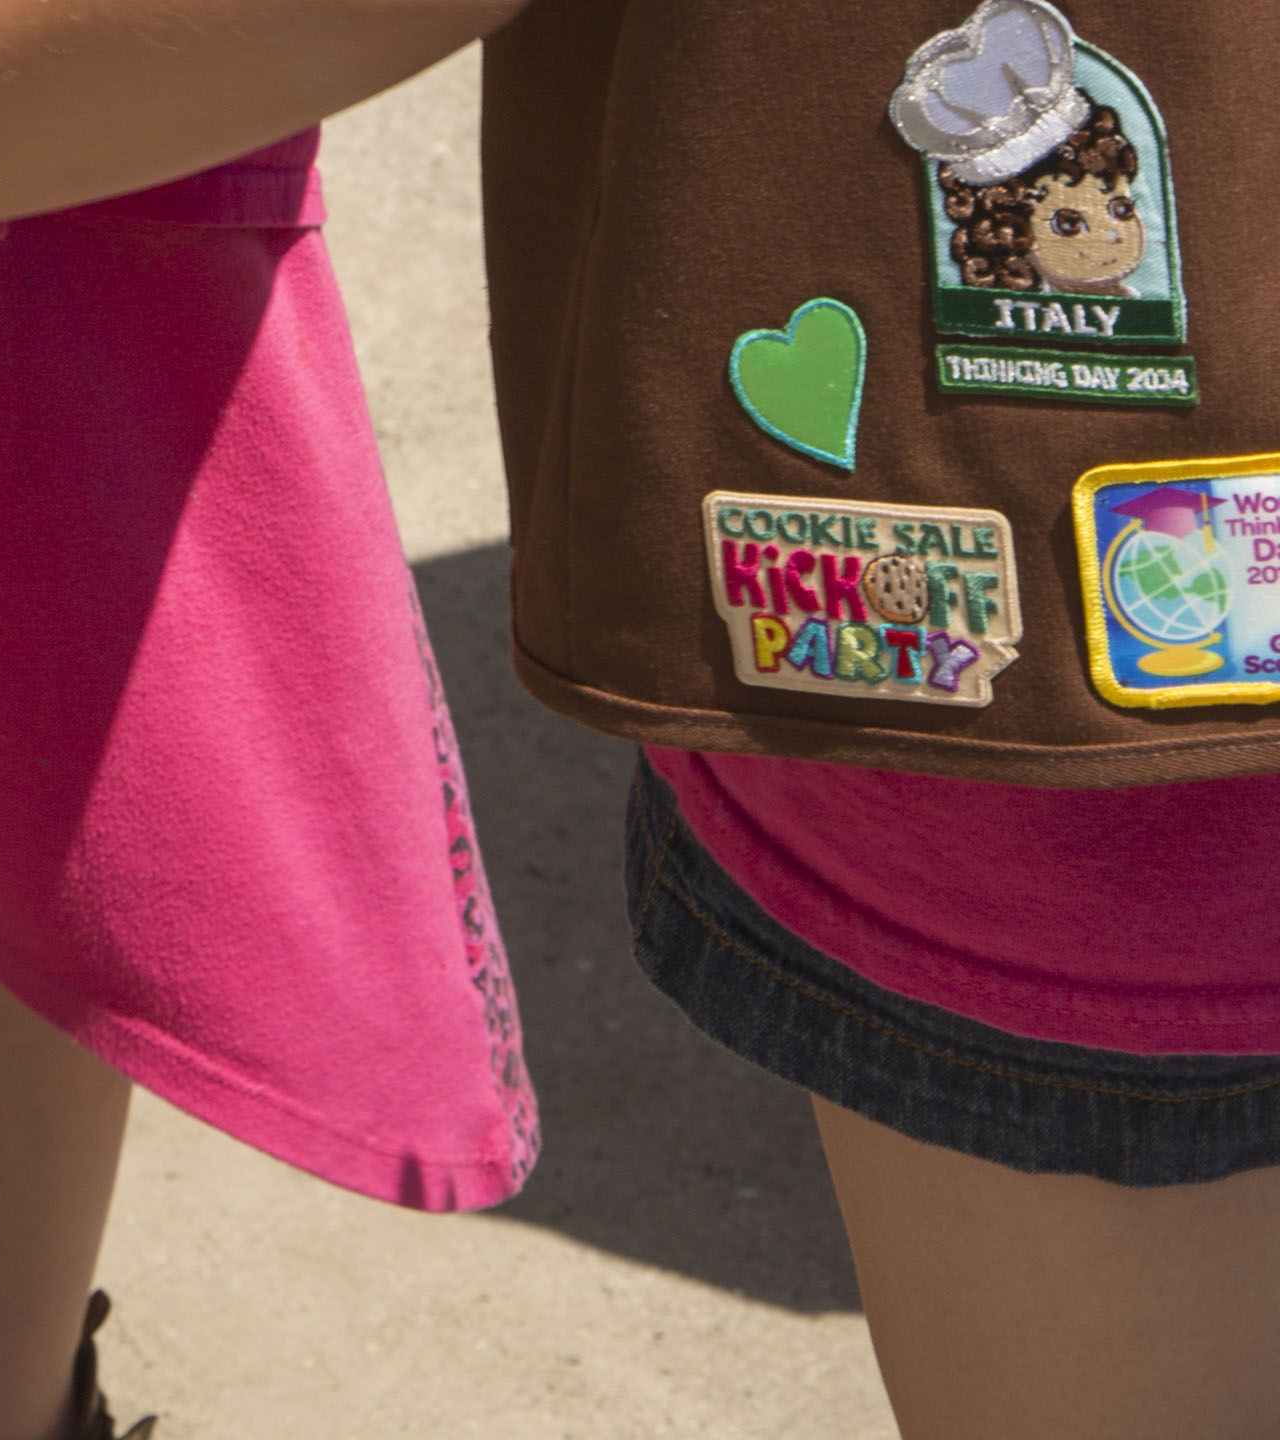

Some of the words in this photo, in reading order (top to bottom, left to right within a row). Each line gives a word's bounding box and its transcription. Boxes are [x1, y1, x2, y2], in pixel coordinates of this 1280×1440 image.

[993, 298, 1121, 337] ITALY
[945, 355, 1069, 388] THINKING
[1071, 364, 1121, 390] DAY
[1126, 367, 1189, 394] 2014
[1232, 492, 1280, 515] Wo
[718, 506, 880, 550] COOKIE
[893, 521, 999, 560] SALE
[749, 611, 982, 693] PARTY
